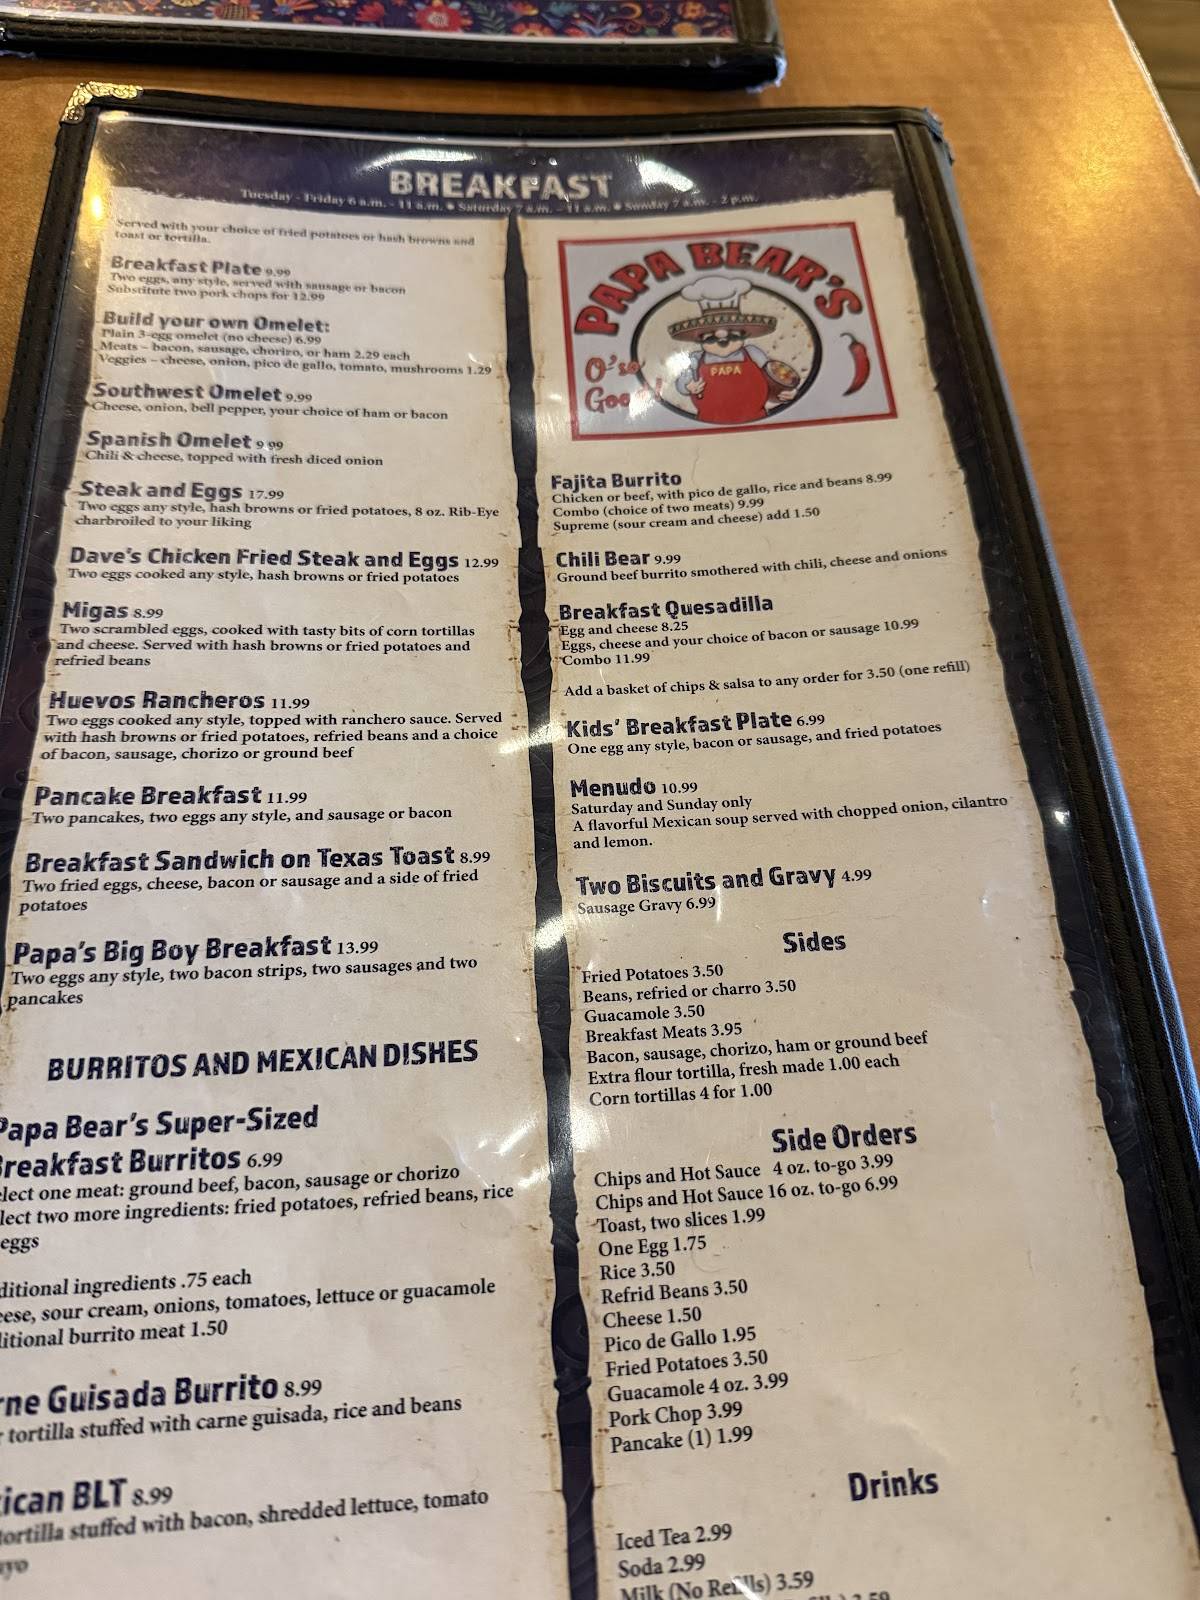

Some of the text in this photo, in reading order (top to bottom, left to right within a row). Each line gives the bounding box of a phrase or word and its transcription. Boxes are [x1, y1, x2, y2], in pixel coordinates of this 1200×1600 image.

[388, 169, 613, 200] BREAKFAST
[240, 188, 291, 202] Tuesday
[303, 193, 346, 208] Friday
[111, 256, 208, 273] Breakfast
[212, 260, 262, 276] Plate
[574, 240, 863, 336] PAPA BEAR'S
[103, 311, 329, 332] Build your own Omelet:
[710, 364, 741, 376] PAPA
[93, 382, 312, 402] Southwest Omelet 9.99
[92, 401, 142, 412] Cheese,
[144, 403, 187, 412] onion,
[190, 402, 214, 412] bell
[218, 406, 266, 416] pepper,
[269, 408, 300, 418] your
[302, 406, 343, 416] choice
[346, 408, 360, 417] of
[362, 408, 390, 418] ham
[410, 410, 448, 419] bacon
[79, 480, 284, 501] Steak and Eggs 17.99
[551, 472, 681, 493] Fajita Burrito
[70, 547, 498, 572] Dave's Chicken Fried Steak and Eggs 12.99
[557, 550, 947, 582] Ground beef burrito smothered with chili, cheese and onions
[62, 602, 163, 623] Migas 8.99
[559, 596, 773, 620] Breakfast Quesadilla
[60, 624, 90, 634] Two
[93, 624, 168, 634] scrambled
[172, 627, 207, 637] eggs,
[212, 624, 263, 634] cooked
[267, 625, 299, 635] with
[303, 627, 336, 639] tasty
[340, 626, 365, 636] bits
[369, 626, 384, 636] of
[422, 626, 474, 636] tortillas
[49, 690, 310, 709] Huevos Rancheros 11.99
[567, 712, 825, 738] Kids' Breakfast Plate 6.99
[570, 777, 697, 798] Menudo 10.99
[32, 807, 452, 827] Two pancakes, two eggs any style, and sausage or bacon
[26, 846, 490, 872] Breakfast Sandwich on Texas Toast 8.99
[576, 866, 871, 896] Two Biscuits and Gravy 4.99
[14, 935, 378, 970] Papa's Big Boy Breakfast 13.99
[783, 932, 846, 953] Sides
[582, 964, 723, 983] Fried Potatoes 3.50
[583, 980, 796, 1003] Beans, refried or charro 3.50
[48, 1040, 478, 1081] BURRITOS AND MEXICAN DISHES
[66, 1112, 148, 1138] Bear's
[156, 1104, 318, 1140] Super-Sized
[772, 1123, 916, 1153] Side Orders
[0, 1147, 282, 1178] reakfast Burritos 6.99
[594, 1154, 893, 1190] Chips and Hot Sauce 4 oz. to-go 3.99
[599, 1235, 706, 1258] One Egg 1.75
[602, 1279, 747, 1304] Refrid Beans 3.50
[48, 1374, 322, 1414] Guisada Burrito 8.99
[9, 1397, 462, 1443] tortilla stuffed with carne guisada, rice and beans
[72, 1478, 172, 1510] BLT 8.99
[848, 1468, 938, 1501] Drinks
[616, 1524, 732, 1550] Iced Tea 2.99
